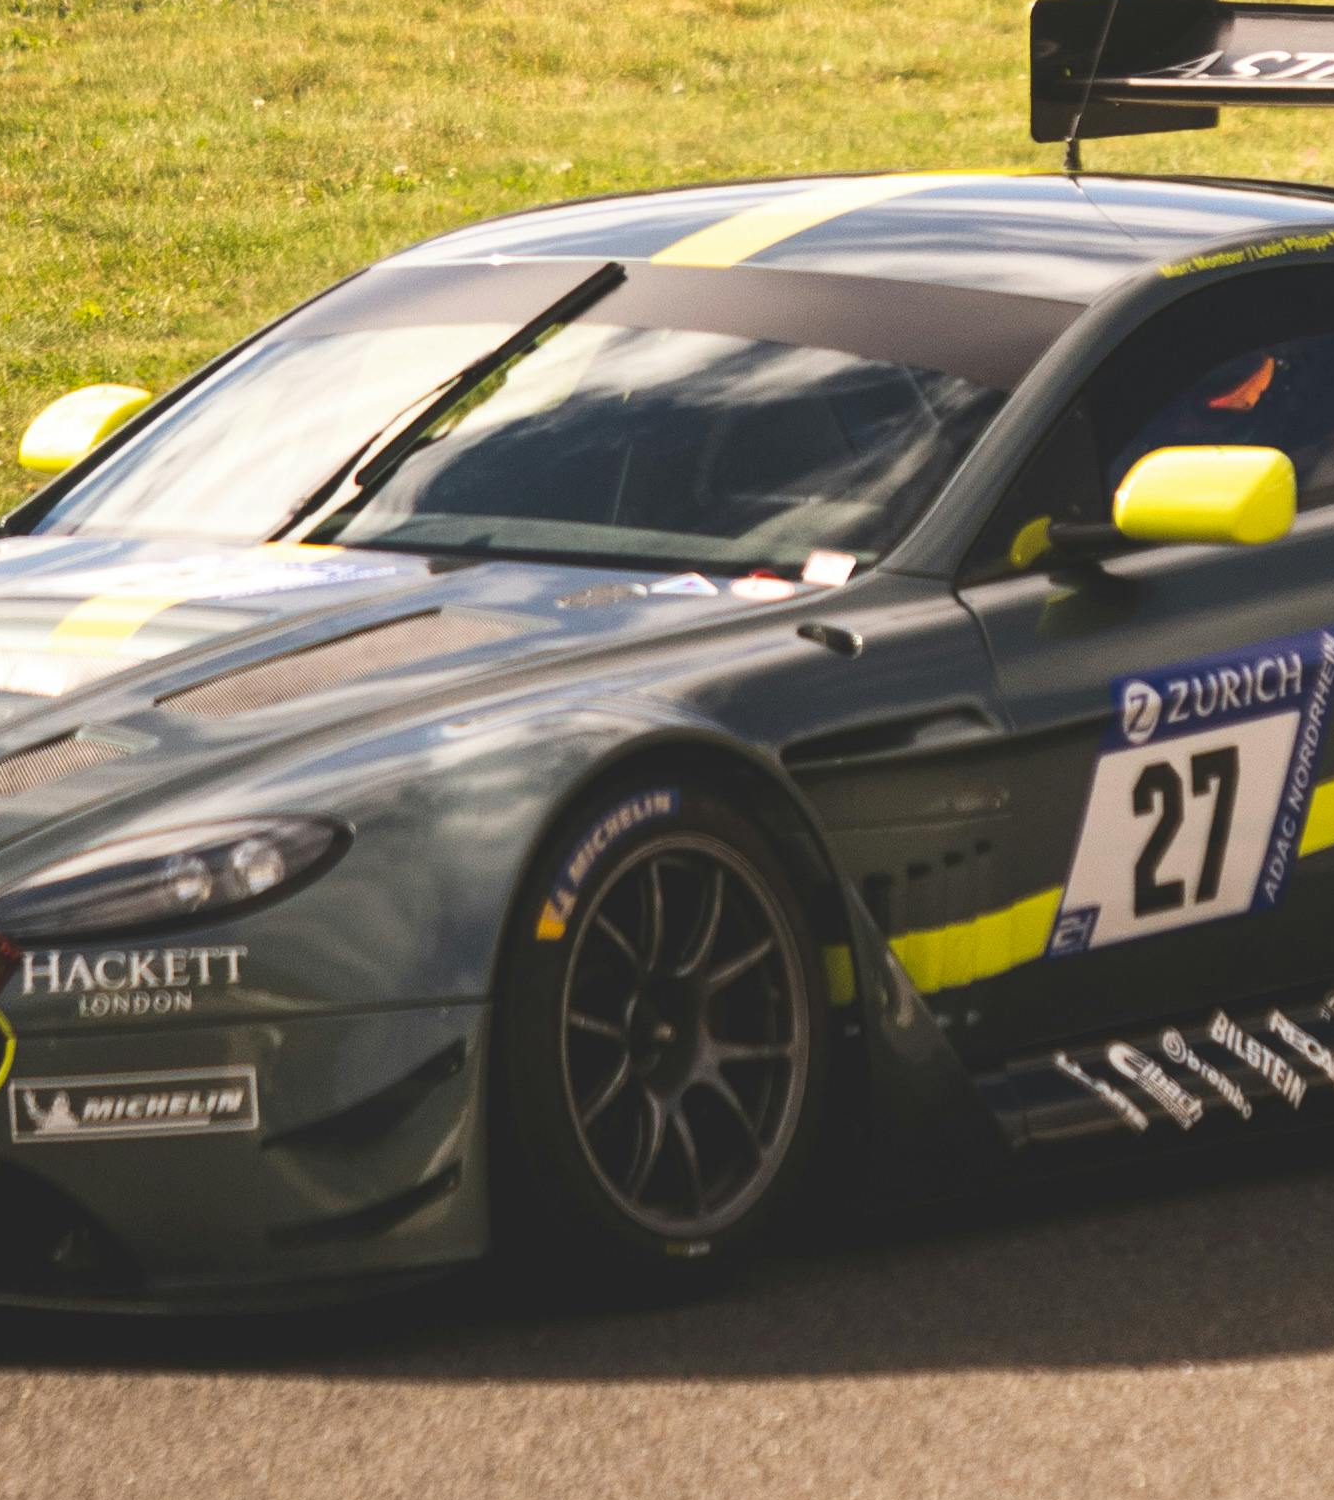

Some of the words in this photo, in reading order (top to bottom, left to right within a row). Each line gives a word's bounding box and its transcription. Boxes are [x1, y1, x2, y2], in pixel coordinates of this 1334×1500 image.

[1167, 652, 1302, 724] ZURICH
[568, 791, 671, 887] MICHELIN
[1133, 745, 1240, 919] 27
[1265, 816, 1298, 903] ADAC
[22, 945, 248, 995] HACKETT
[78, 989, 193, 1018] LONDON
[1186, 1048, 1253, 1120] brembo
[1210, 1009, 1307, 1110] BILSTEIN
[82, 1087, 244, 1121] MICHELIN
